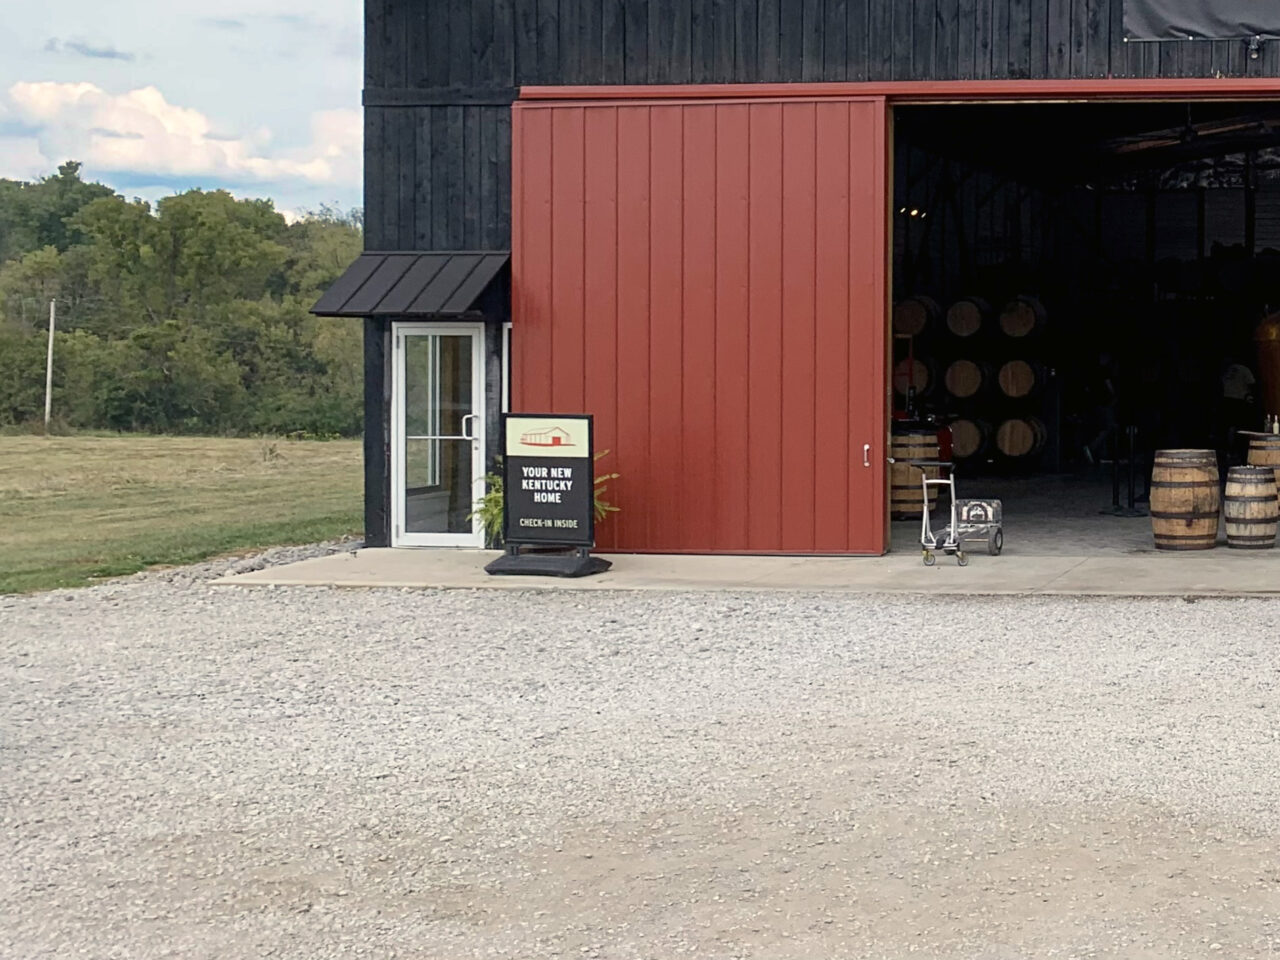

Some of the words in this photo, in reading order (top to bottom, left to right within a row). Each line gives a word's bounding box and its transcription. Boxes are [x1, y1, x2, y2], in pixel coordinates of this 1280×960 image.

[521, 466, 548, 478] YOUR
[550, 467, 573, 479] NEW
[521, 479, 573, 491] KENTUCKY
[533, 492, 562, 504] HOME
[519, 518, 553, 528] CHECK-IN
[554, 519, 578, 529] INSIDE
